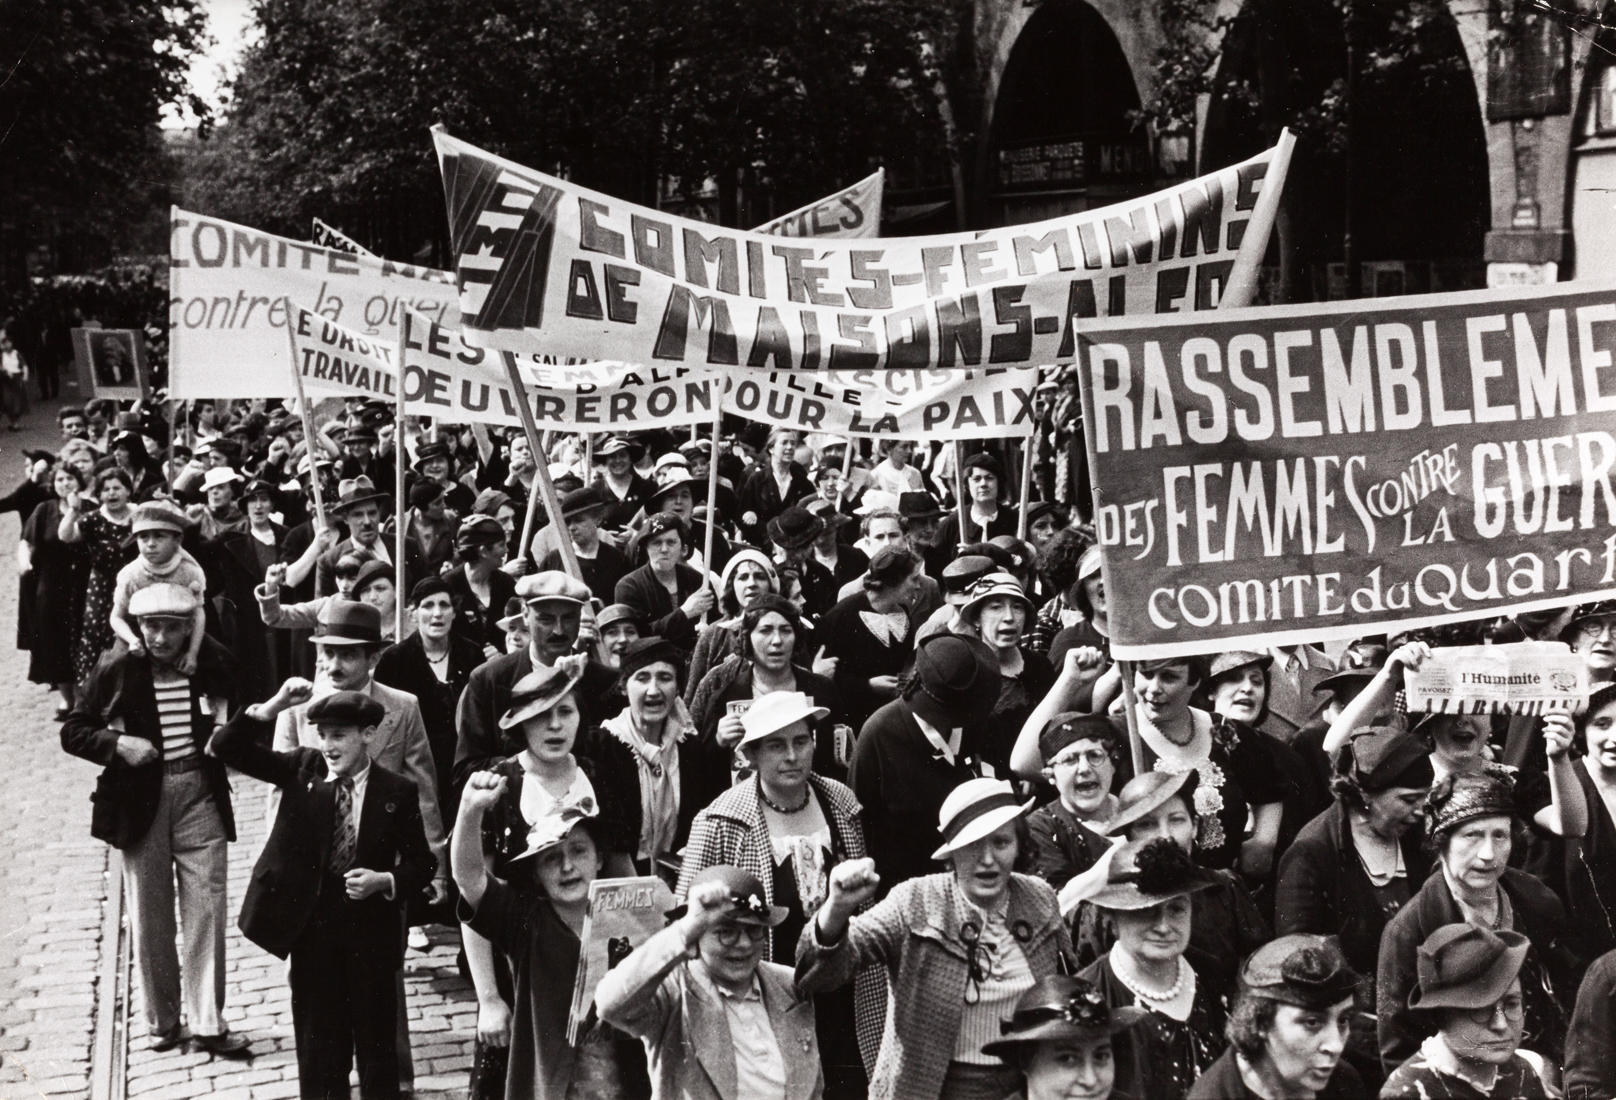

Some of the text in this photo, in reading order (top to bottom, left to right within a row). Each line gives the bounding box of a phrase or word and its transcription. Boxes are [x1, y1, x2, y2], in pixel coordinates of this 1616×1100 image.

[565, 258, 642, 324] DE
[301, 347, 397, 398] TRAVAIL
[404, 365, 719, 424] OEUVRERON
[849, 409, 901, 433] LA
[922, 385, 1036, 432] PAIX
[1089, 303, 1616, 453] RASSEMBLEME
[1099, 443, 1461, 567] DES FEMMES CONTRE
[1401, 506, 1456, 547] LA
[597, 887, 655, 913] FEMMES
